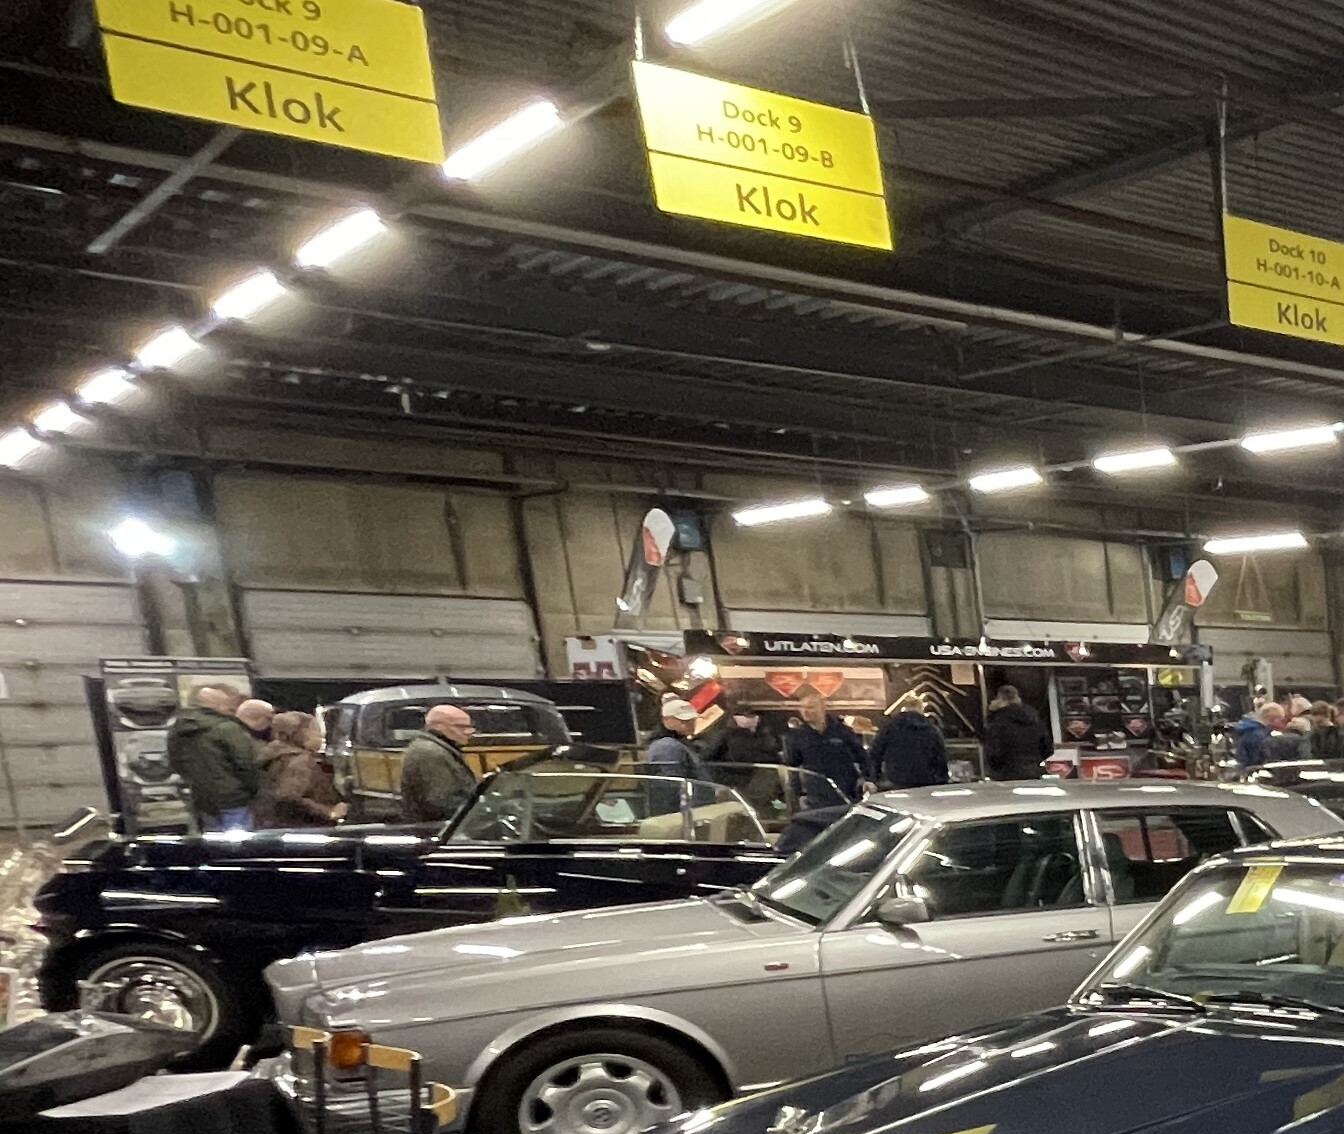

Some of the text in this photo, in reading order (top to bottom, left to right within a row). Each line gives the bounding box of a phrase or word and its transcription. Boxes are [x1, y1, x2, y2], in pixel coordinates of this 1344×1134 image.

[302, 0, 321, 21] 9
[169, 1, 369, 67] H-001-09-A
[224, 76, 345, 133] Klok
[722, 100, 802, 134] Dock 9
[696, 124, 835, 169] H-001-09-B
[735, 183, 821, 227] Klok
[1268, 238, 1327, 265] Dock 10
[1256, 257, 1341, 290] H-001-10-A
[1277, 302, 1327, 333] Klok
